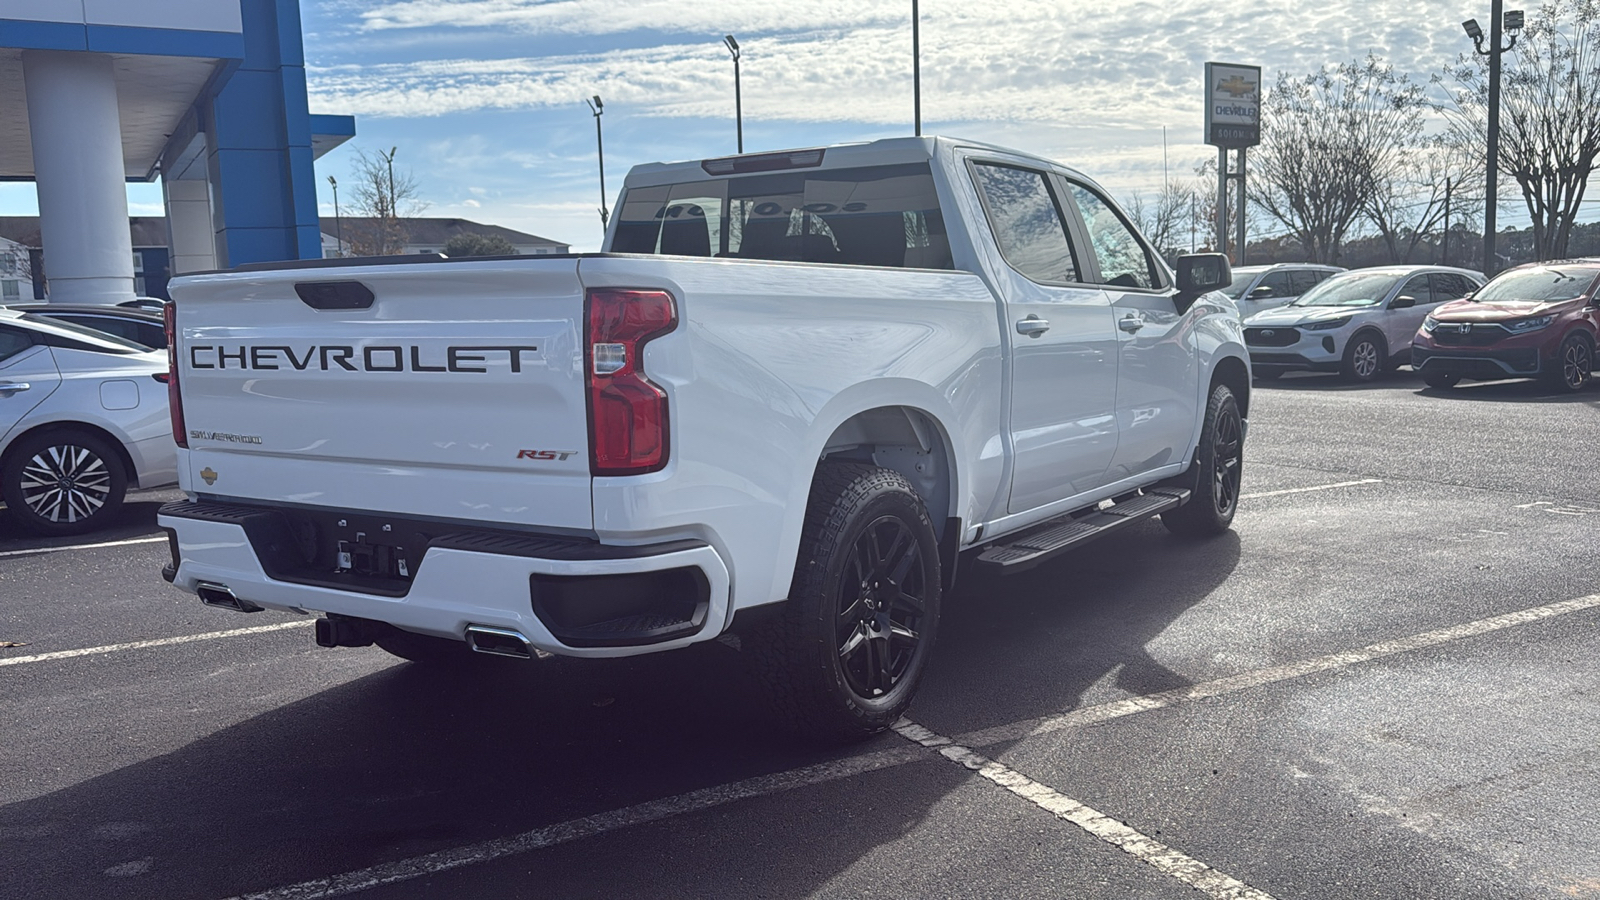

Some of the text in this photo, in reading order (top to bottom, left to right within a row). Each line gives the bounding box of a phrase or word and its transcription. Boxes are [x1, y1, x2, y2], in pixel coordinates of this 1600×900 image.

[1218, 129, 1255, 139] SOLOMN
[190, 346, 537, 373] CHEVROLET
[516, 449, 579, 461] RST
